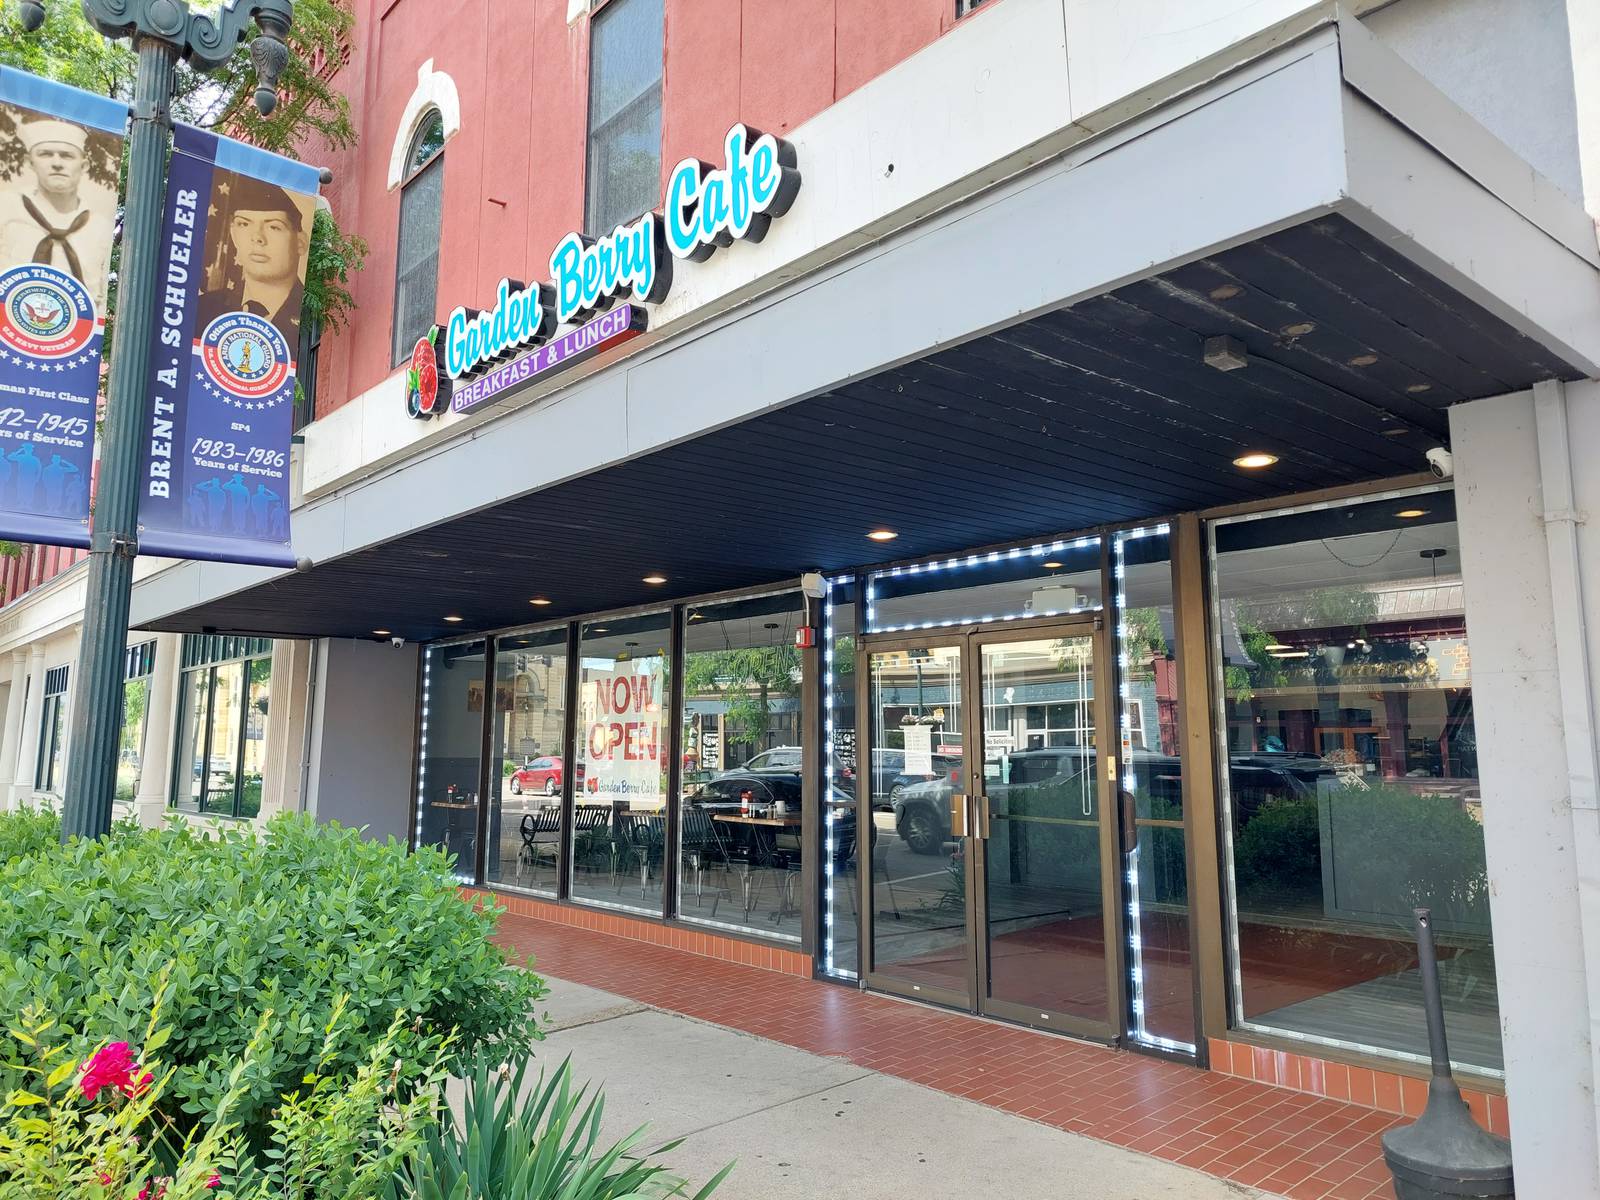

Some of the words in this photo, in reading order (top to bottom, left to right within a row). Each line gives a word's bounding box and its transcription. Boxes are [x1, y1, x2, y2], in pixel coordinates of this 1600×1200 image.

[161, 189, 198, 348] SCHUELER
[447, 283, 541, 376] Garden
[552, 220, 653, 318] Berry
[668, 130, 777, 252] Cafe
[31, 268, 76, 292] Thanks
[74, 290, 88, 312] You
[208, 319, 238, 341] Ottawa
[238, 317, 274, 339] Thanks
[272, 337, 283, 356] You
[221, 339, 231, 360] ARMY
[228, 332, 262, 345] NATIONAL
[261, 345, 272, 369] GUARD
[157, 358, 179, 388] A.
[453, 353, 541, 411] BREAKFAST
[546, 345, 558, 364] &
[563, 307, 629, 357] LUNCH
[28, 386, 56, 399] First
[58, 391, 90, 404] Class
[15, 430, 31, 440] of
[32, 432, 84, 448] Service
[230, 422, 251, 433] SP4
[150, 396, 175, 499] BRENT
[191, 437, 285, 468] 1983-1986
[193, 456, 225, 470] Years
[227, 462, 240, 471] of
[241, 464, 283, 478] Service
[734, 645, 790, 684] OPEN
[595, 672, 657, 715] NOW
[589, 722, 657, 761] OPEN
[599, 777, 620, 793] Garden
[621, 778, 640, 795] Berry
[641, 778, 657, 796] Cafe
